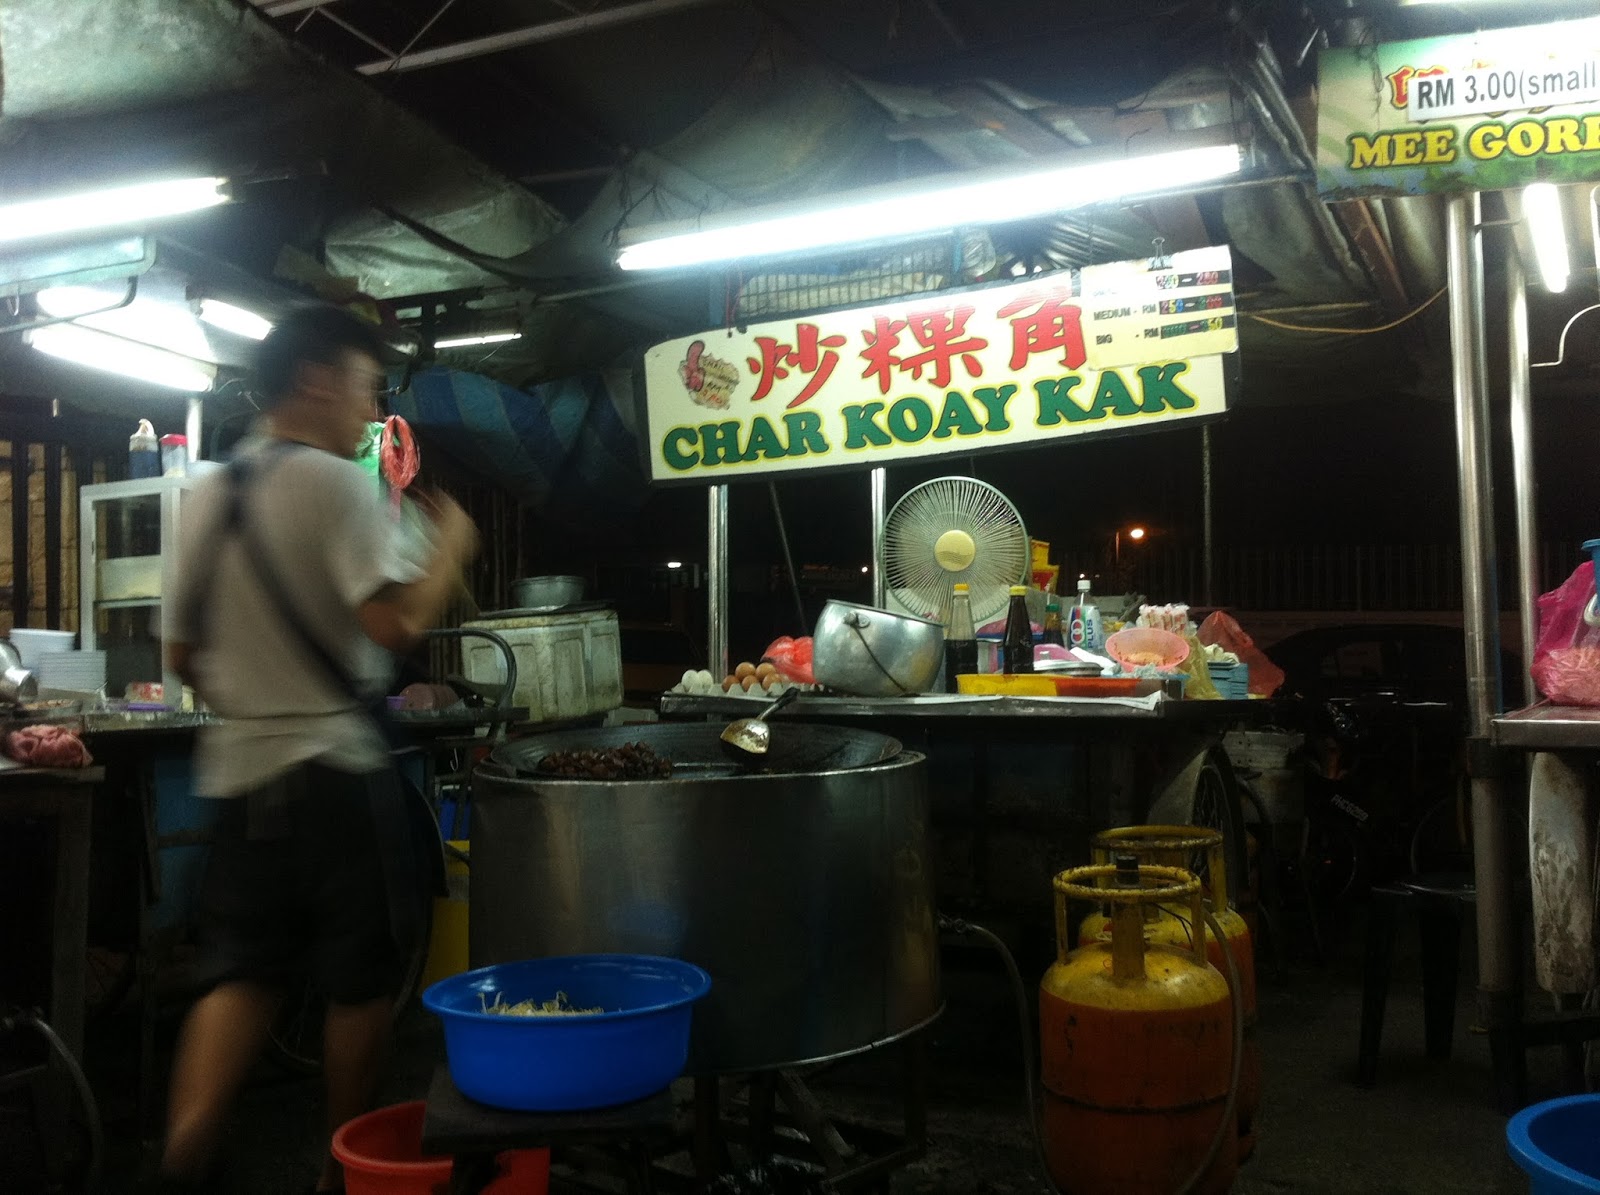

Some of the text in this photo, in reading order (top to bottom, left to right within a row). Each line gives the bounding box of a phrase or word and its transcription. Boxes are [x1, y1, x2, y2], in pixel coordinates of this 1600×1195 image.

[1417, 79, 1454, 109] RM
[1350, 129, 1456, 169] MEE
[1093, 307, 1131, 321] MEDIUM
[1142, 304, 1157, 314] RM
[746, 284, 1087, 410] 炒粿角
[1096, 333, 1113, 346] BIG
[1144, 327, 1159, 339] RM
[662, 361, 1196, 471] CHAR KOAY KAK
